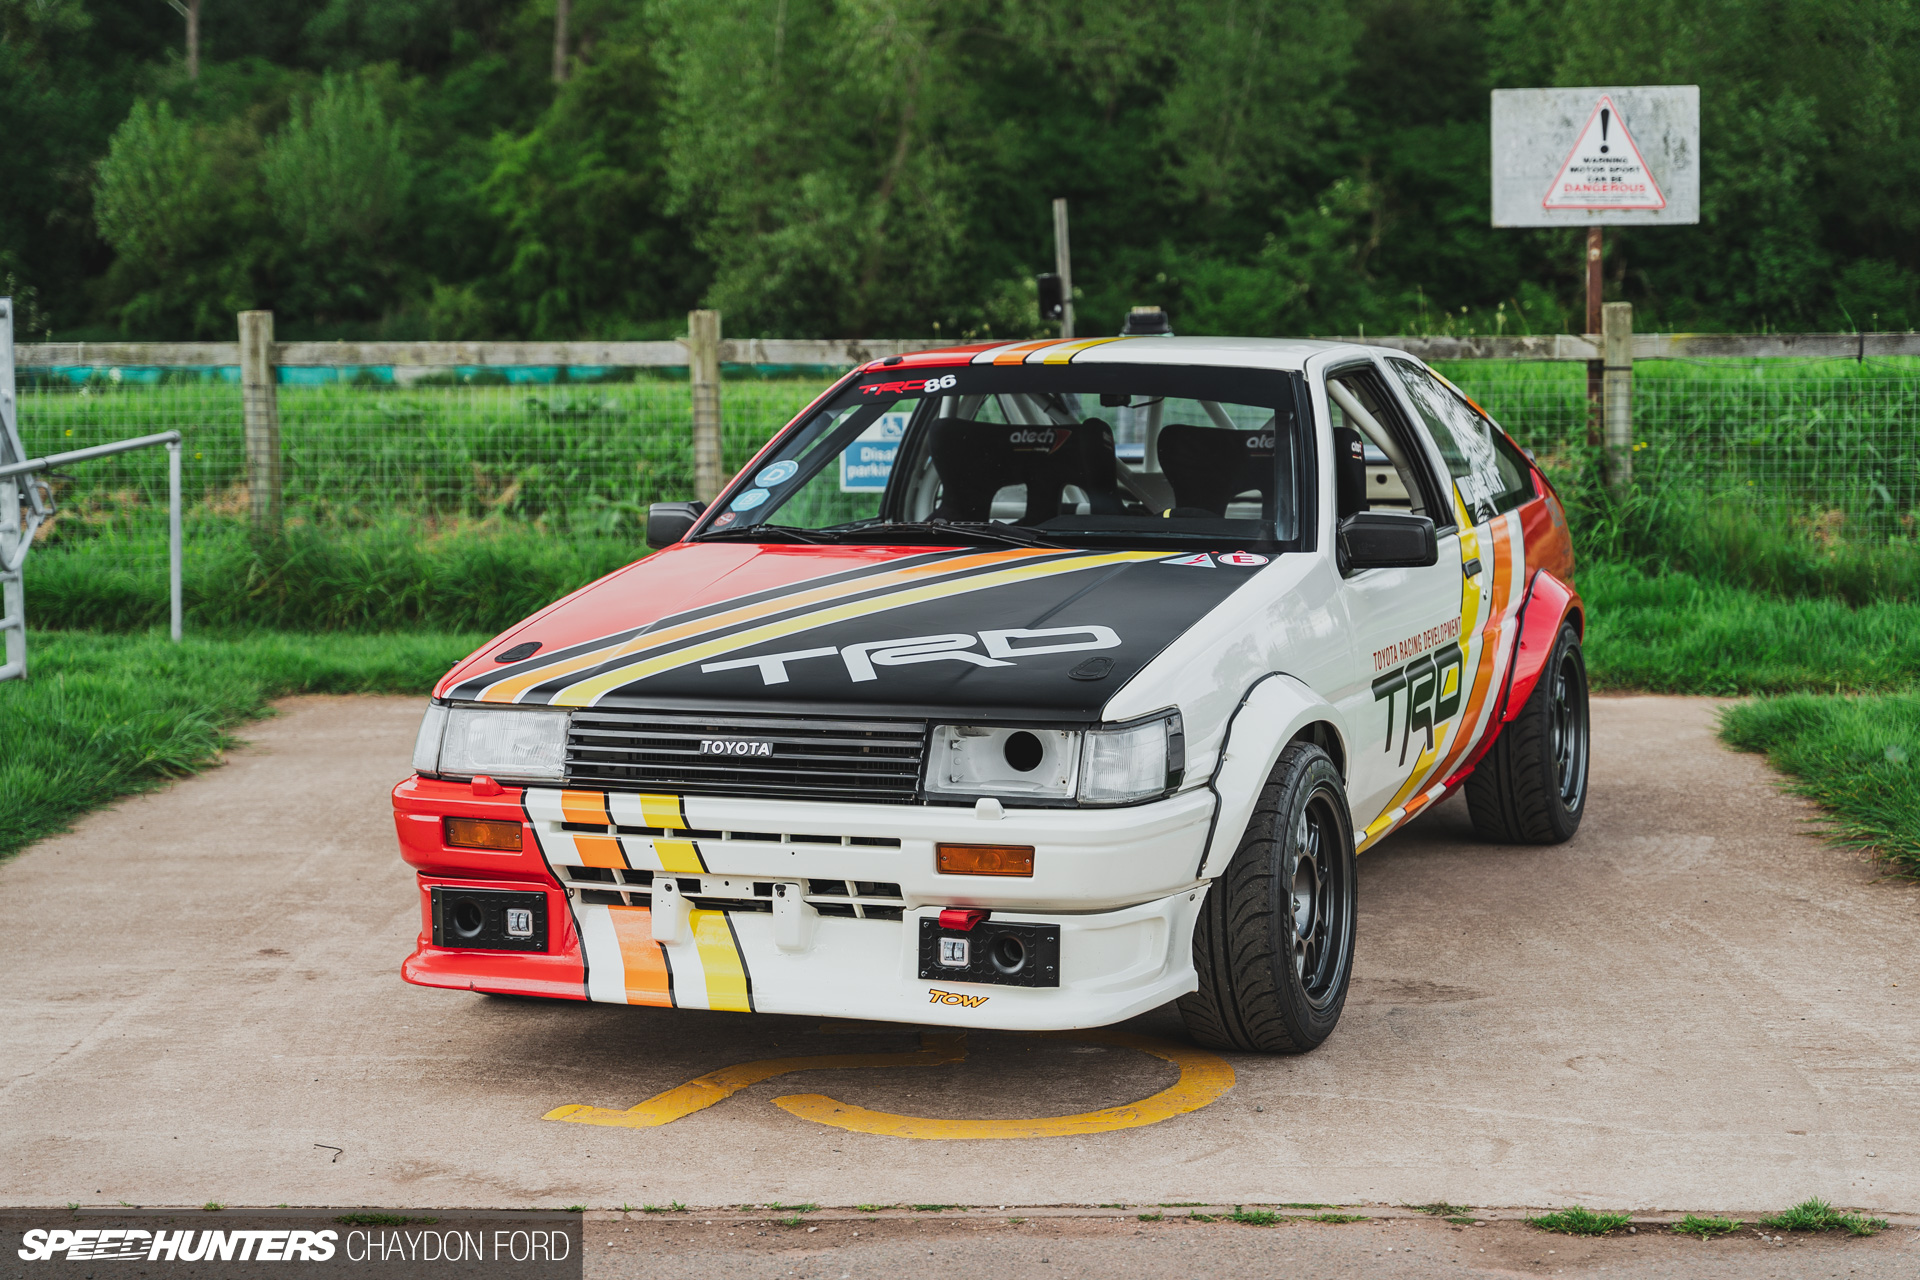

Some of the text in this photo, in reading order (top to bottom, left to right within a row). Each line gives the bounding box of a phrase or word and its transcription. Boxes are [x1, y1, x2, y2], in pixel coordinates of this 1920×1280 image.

[1564, 183, 1646, 192] DANGEROUS
[1010, 428, 1055, 443] atech
[1373, 616, 1462, 672] TOYOTA RACING DEVELOPMENT
[701, 625, 1122, 686] TRD
[1371, 640, 1464, 768] TRD
[702, 740, 770, 756] TOYOTA
[929, 989, 990, 1008] TOW
